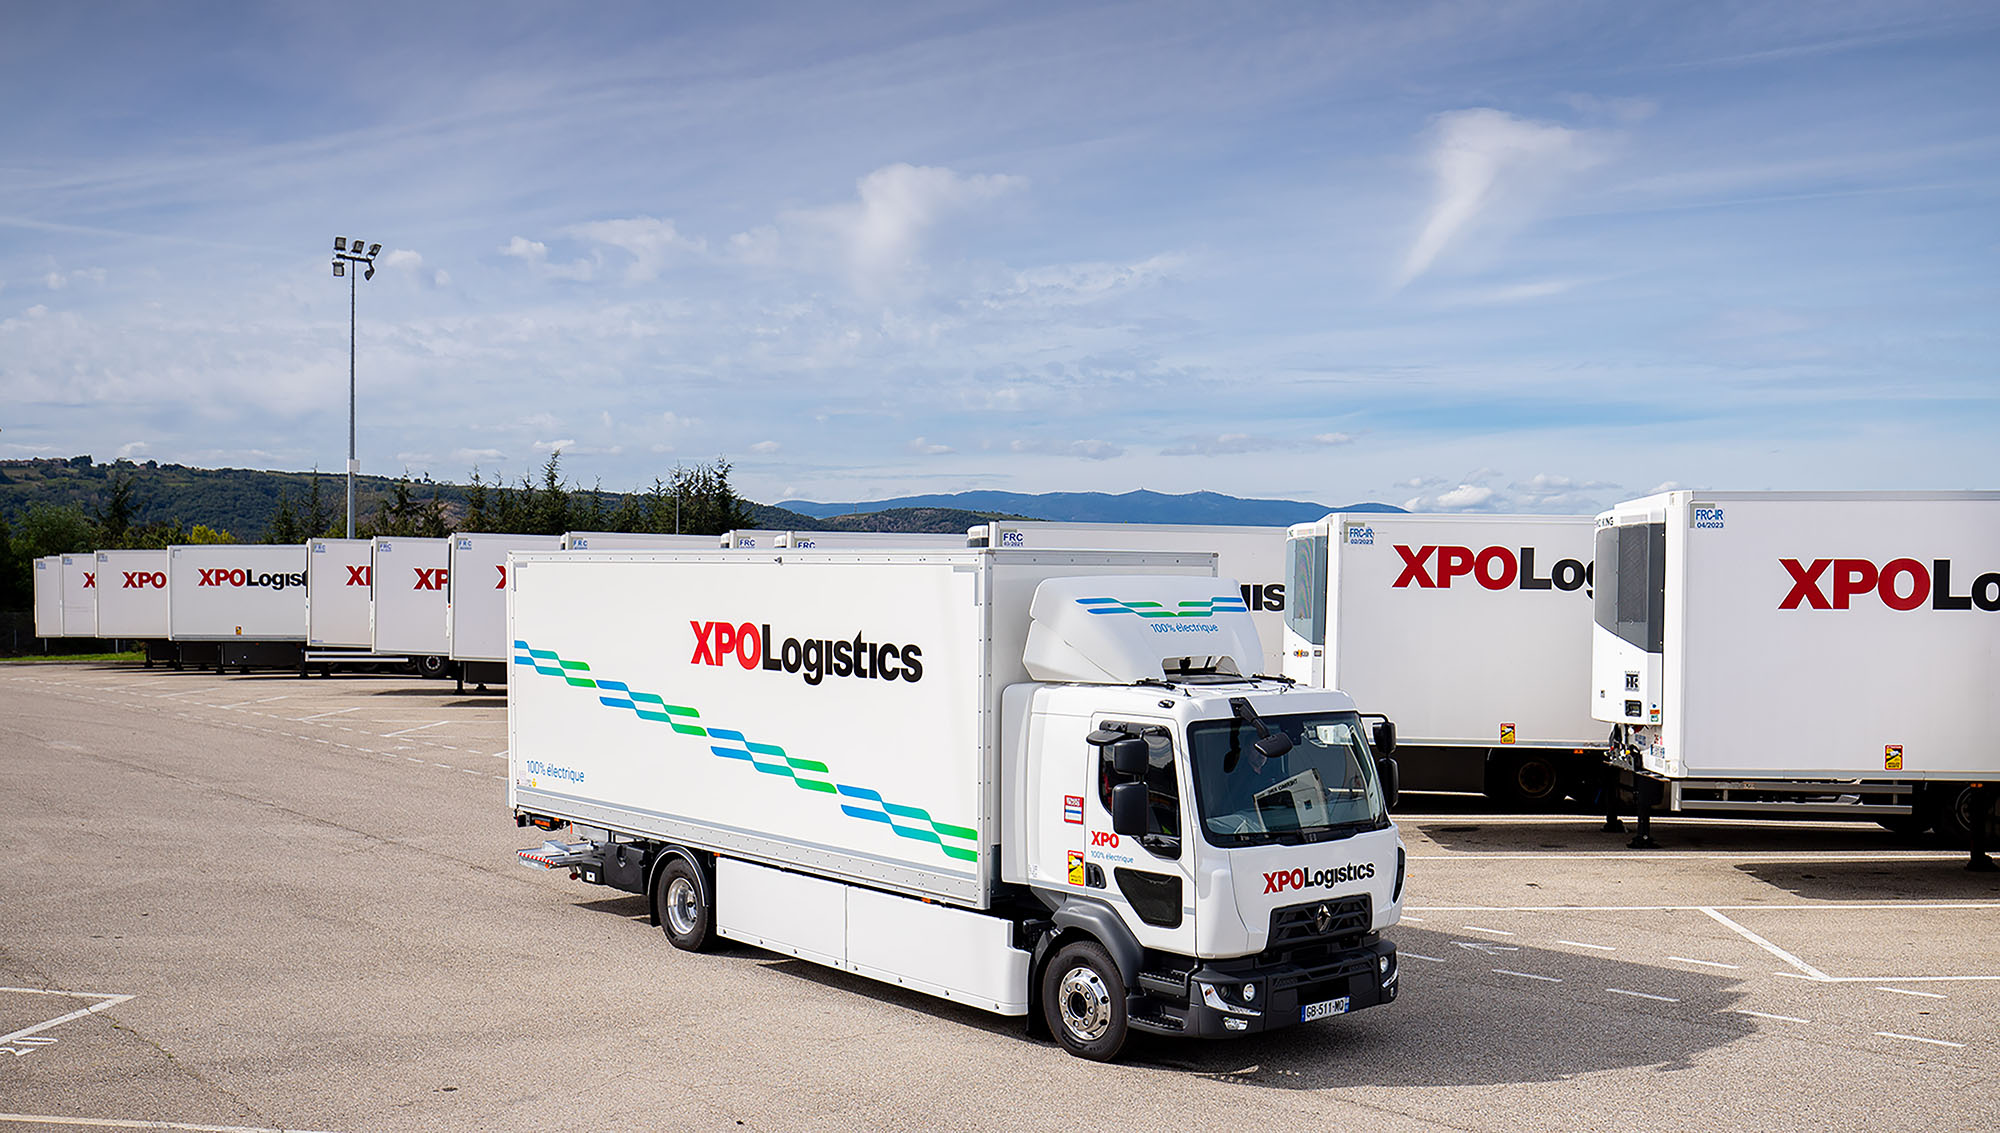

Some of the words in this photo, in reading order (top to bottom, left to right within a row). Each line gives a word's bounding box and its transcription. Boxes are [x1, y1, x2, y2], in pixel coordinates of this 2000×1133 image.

[1695, 509, 1724, 521] FRC-IR
[739, 538, 756, 547] FRC
[798, 541, 816, 549] FRC
[1003, 532, 1024, 541] FRC
[122, 571, 167, 589] XPO
[1392, 544, 1594, 600] XPOLo
[1150, 623, 1176, 633] 100%
[1176, 622, 1219, 634] électrique
[689, 620, 923, 686] XPOLogistics
[527, 760, 546, 776] 100%
[546, 763, 585, 784] électrique
[1090, 830, 1120, 849] XPO
[1262, 862, 1375, 895] XPOLogistics
